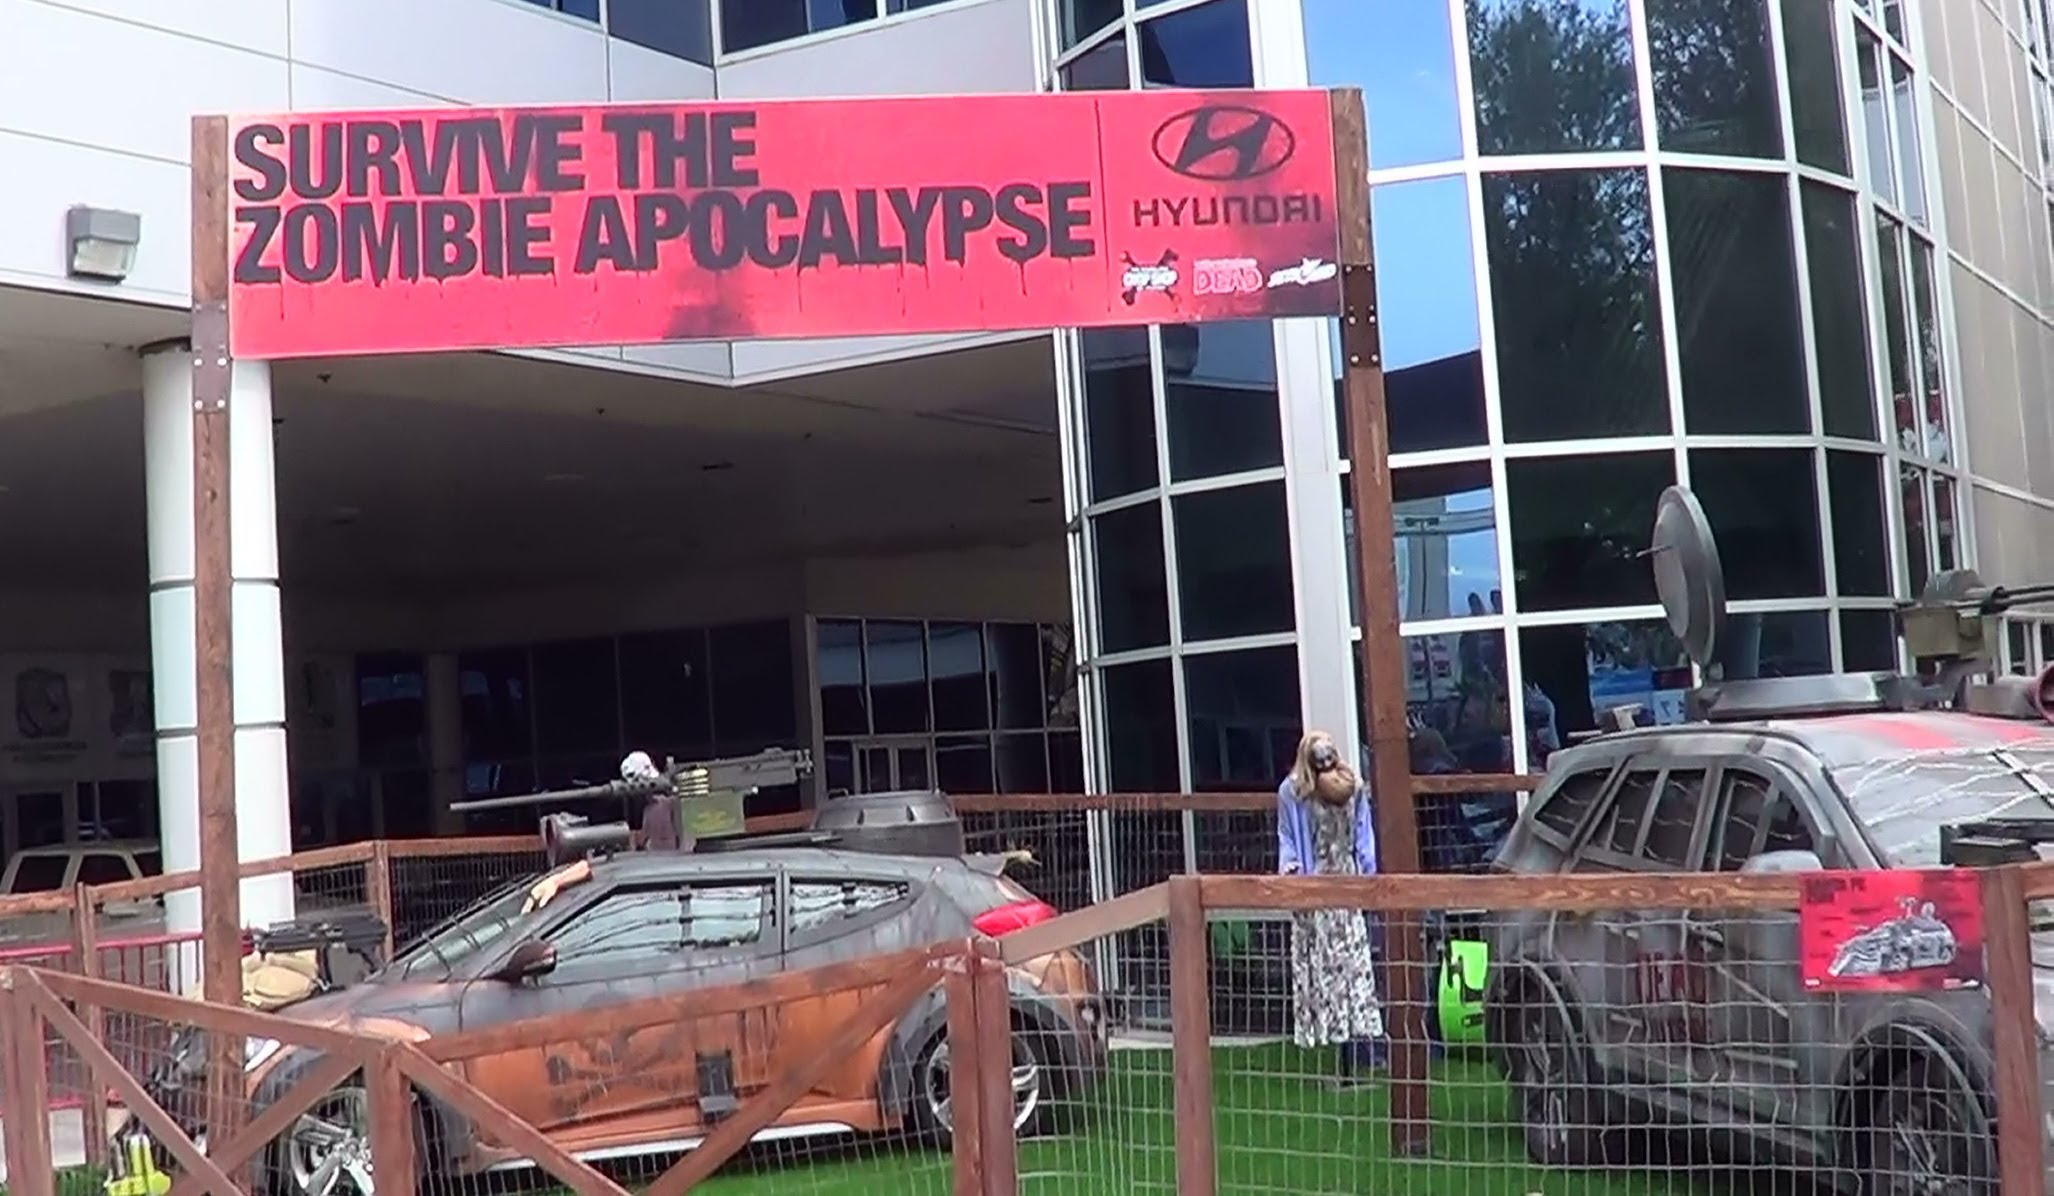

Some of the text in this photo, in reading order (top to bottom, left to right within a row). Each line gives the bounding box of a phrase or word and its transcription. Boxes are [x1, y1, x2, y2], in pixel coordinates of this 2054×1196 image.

[233, 110, 759, 201] SURVIVE THE
[233, 180, 1096, 285] ZOMBIE APOCALYPSE
[1133, 193, 1322, 227] HYUNDAI
[1193, 268, 1263, 295] DEAD
